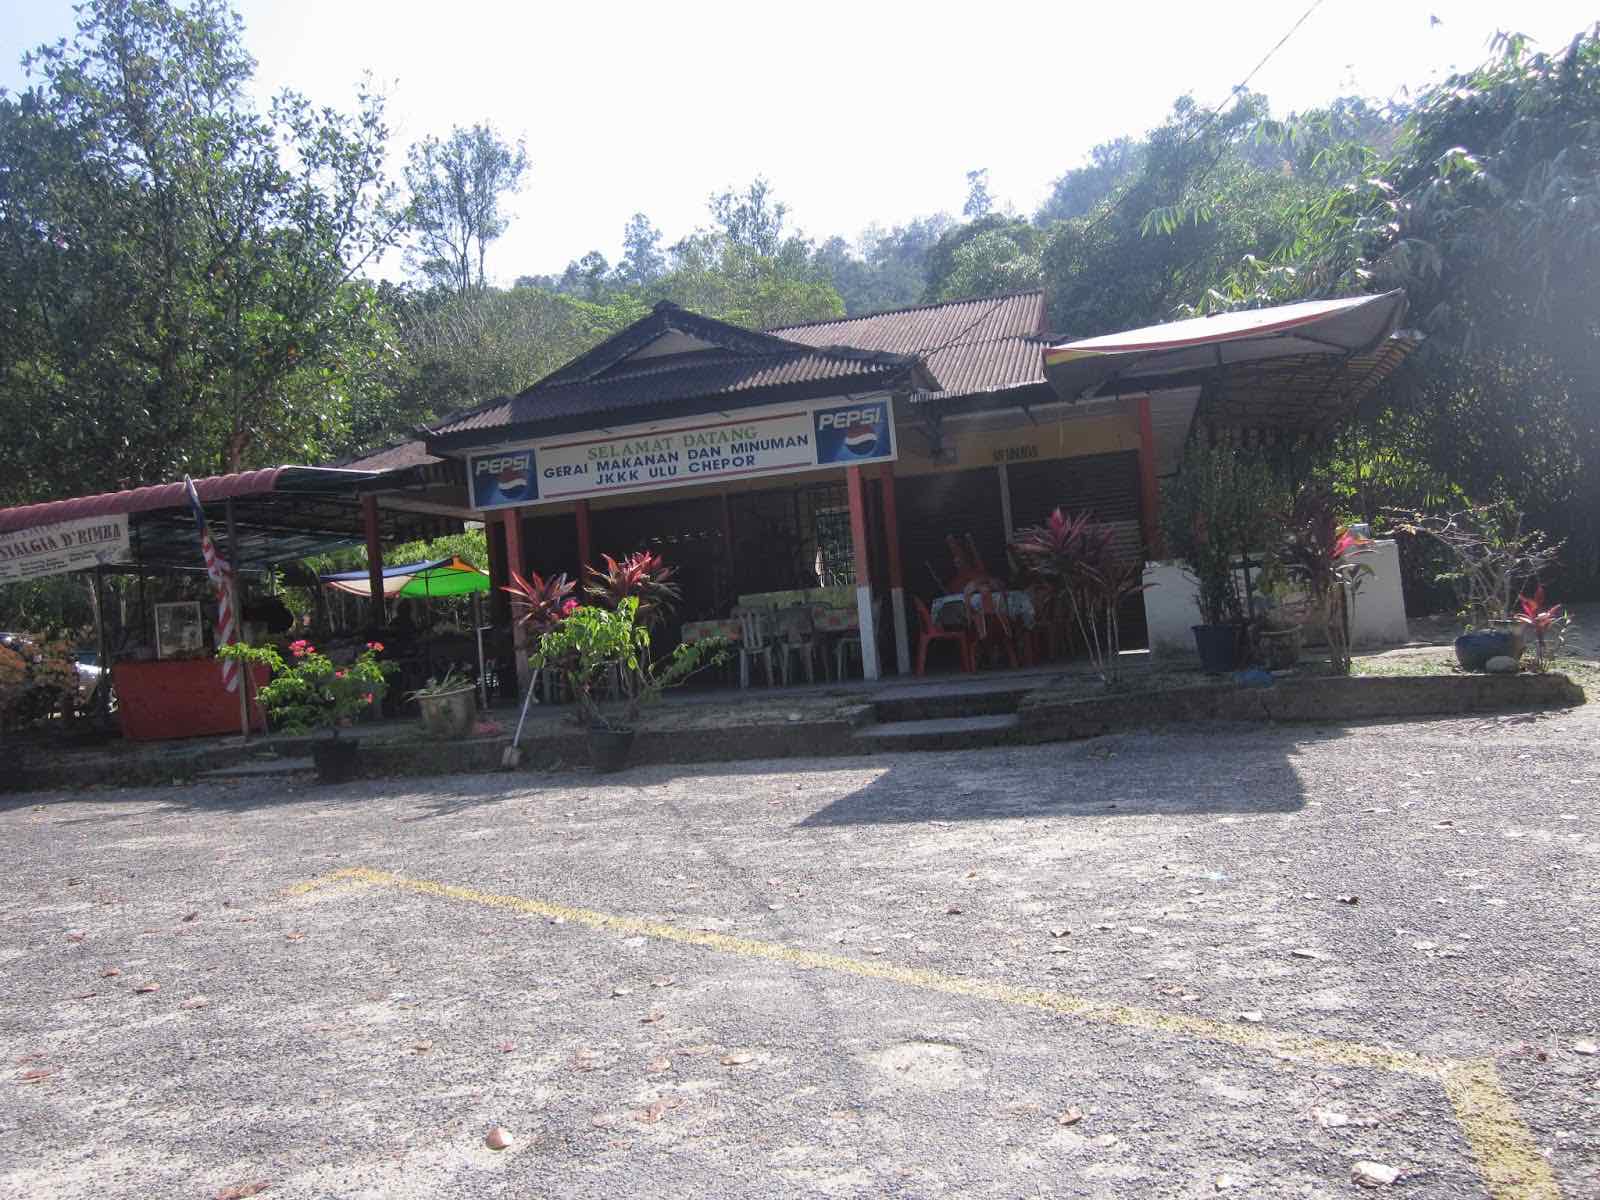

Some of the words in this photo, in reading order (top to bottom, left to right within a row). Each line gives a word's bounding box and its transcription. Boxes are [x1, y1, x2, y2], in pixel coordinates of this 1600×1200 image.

[819, 408, 881, 430] PEPSI
[543, 463, 588, 479] GERAI
[596, 452, 679, 471] MAKANAN
[687, 446, 721, 462] DAN
[730, 434, 809, 454] MINUMAN
[587, 438, 673, 461] SELAMAT
[683, 426, 758, 449] DATANG
[475, 454, 530, 475] PEPSI
[595, 469, 639, 486] JKKK
[648, 464, 678, 479] ULU
[688, 454, 756, 474] CHEPOR
